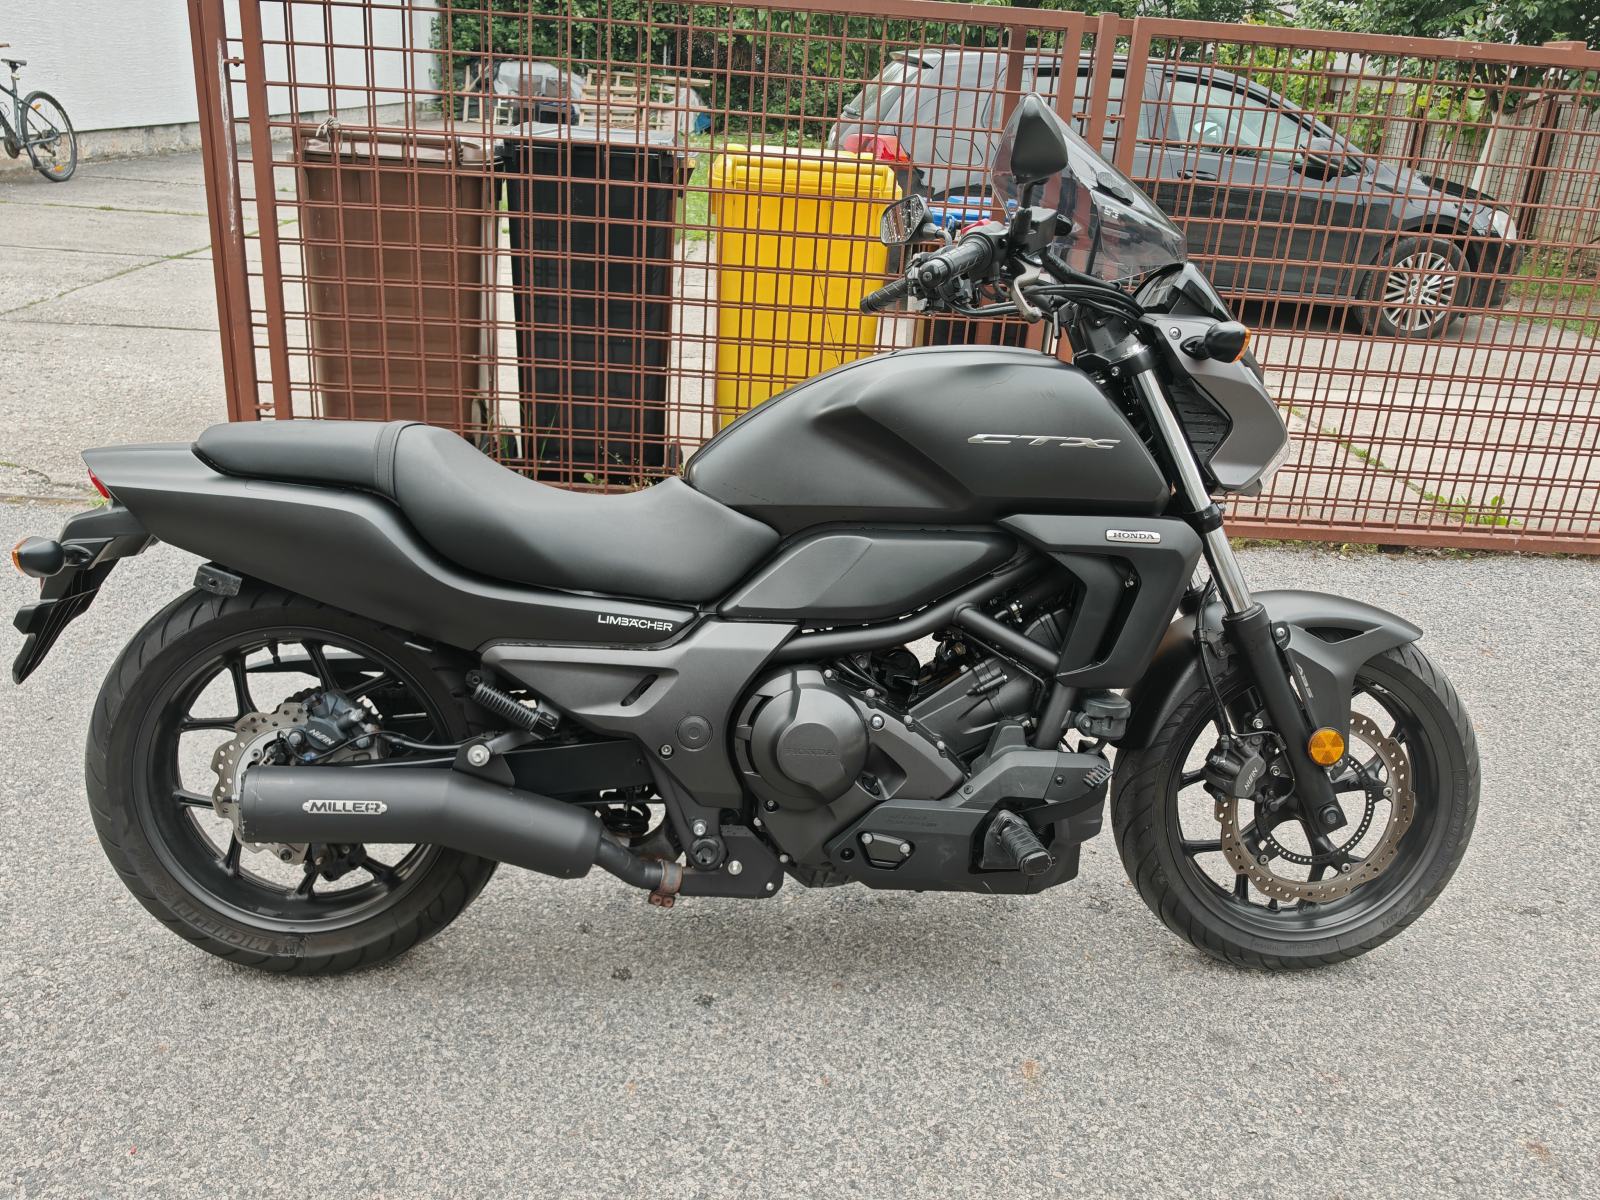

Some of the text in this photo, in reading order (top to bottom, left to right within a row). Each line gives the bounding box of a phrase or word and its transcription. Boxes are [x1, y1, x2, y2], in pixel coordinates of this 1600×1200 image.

[967, 433, 1121, 450] CTX
[1112, 531, 1154, 541] HONDA
[597, 614, 673, 632] LIMBÄCHER
[309, 801, 381, 813] MILLER
